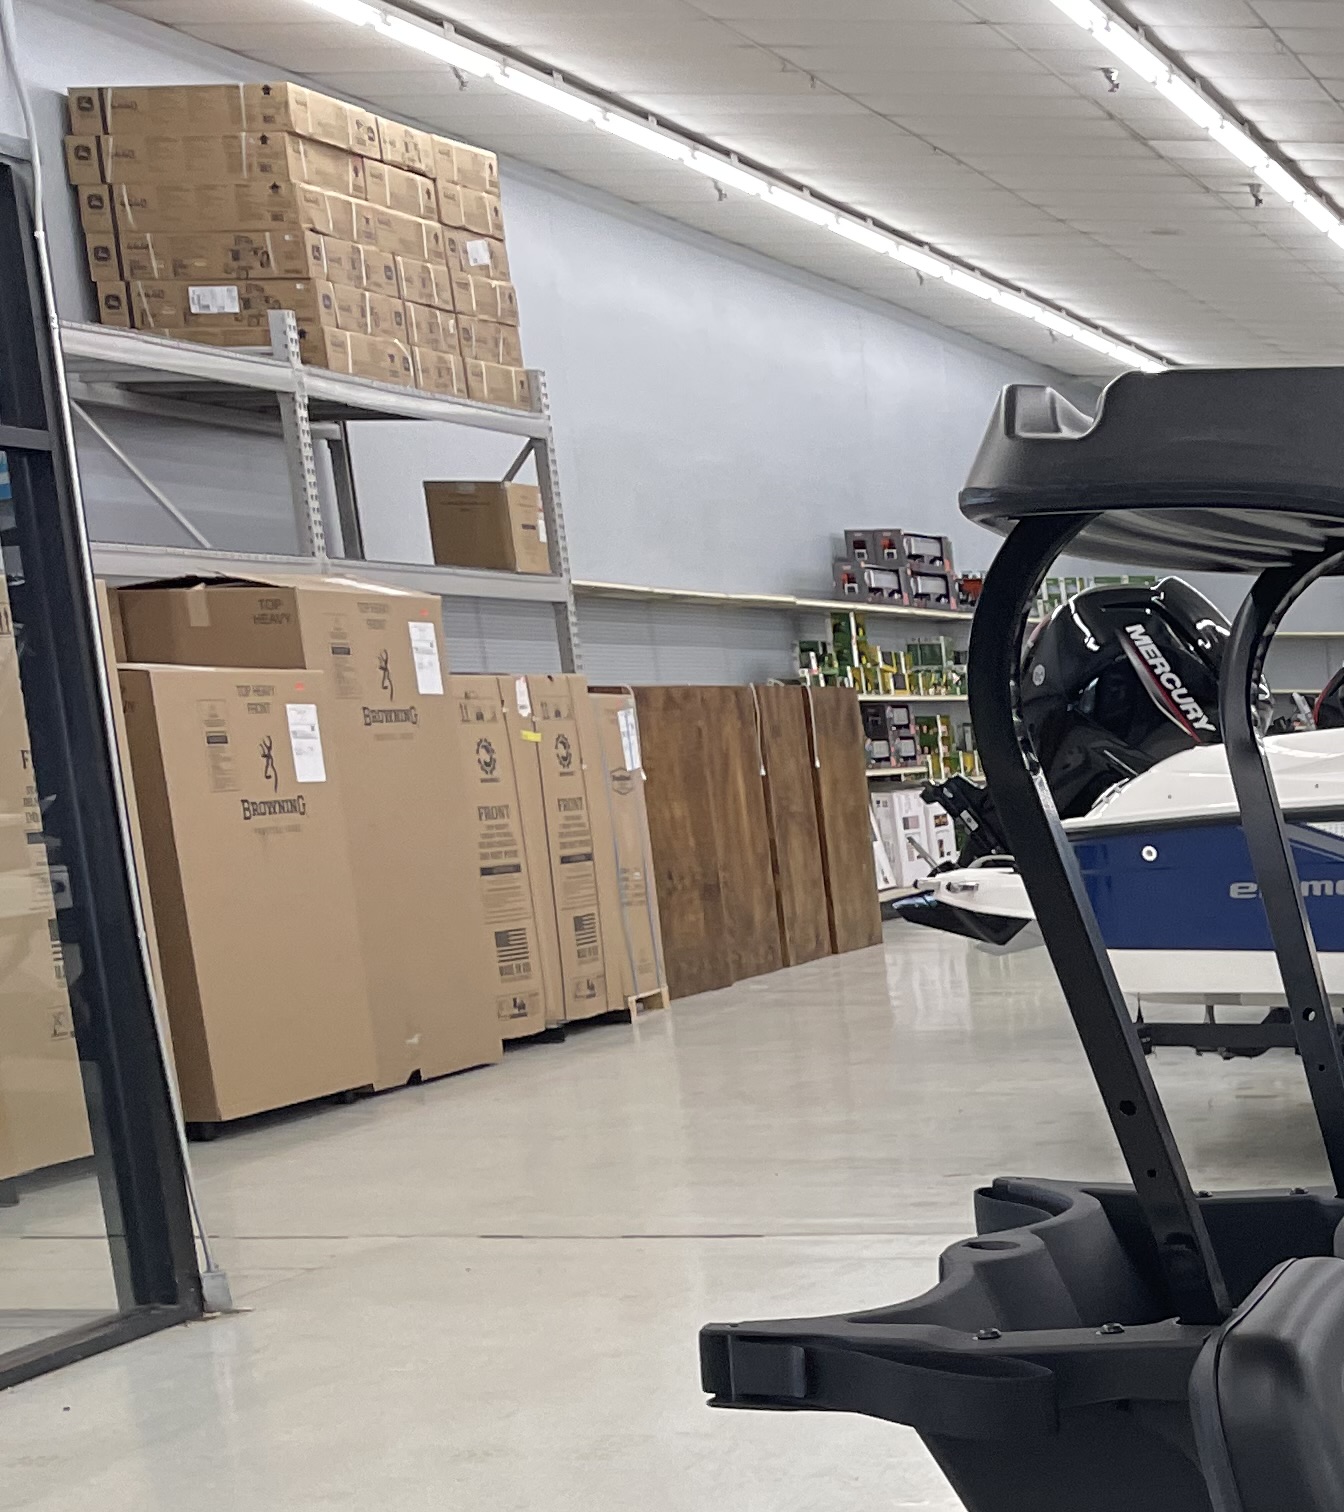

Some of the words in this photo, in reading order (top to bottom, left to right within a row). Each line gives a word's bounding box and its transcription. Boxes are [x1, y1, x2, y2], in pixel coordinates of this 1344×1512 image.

[1124, 623, 1217, 732] MERCURY
[240, 794, 306, 821] BROWNING
[477, 804, 510, 822] FRONT
